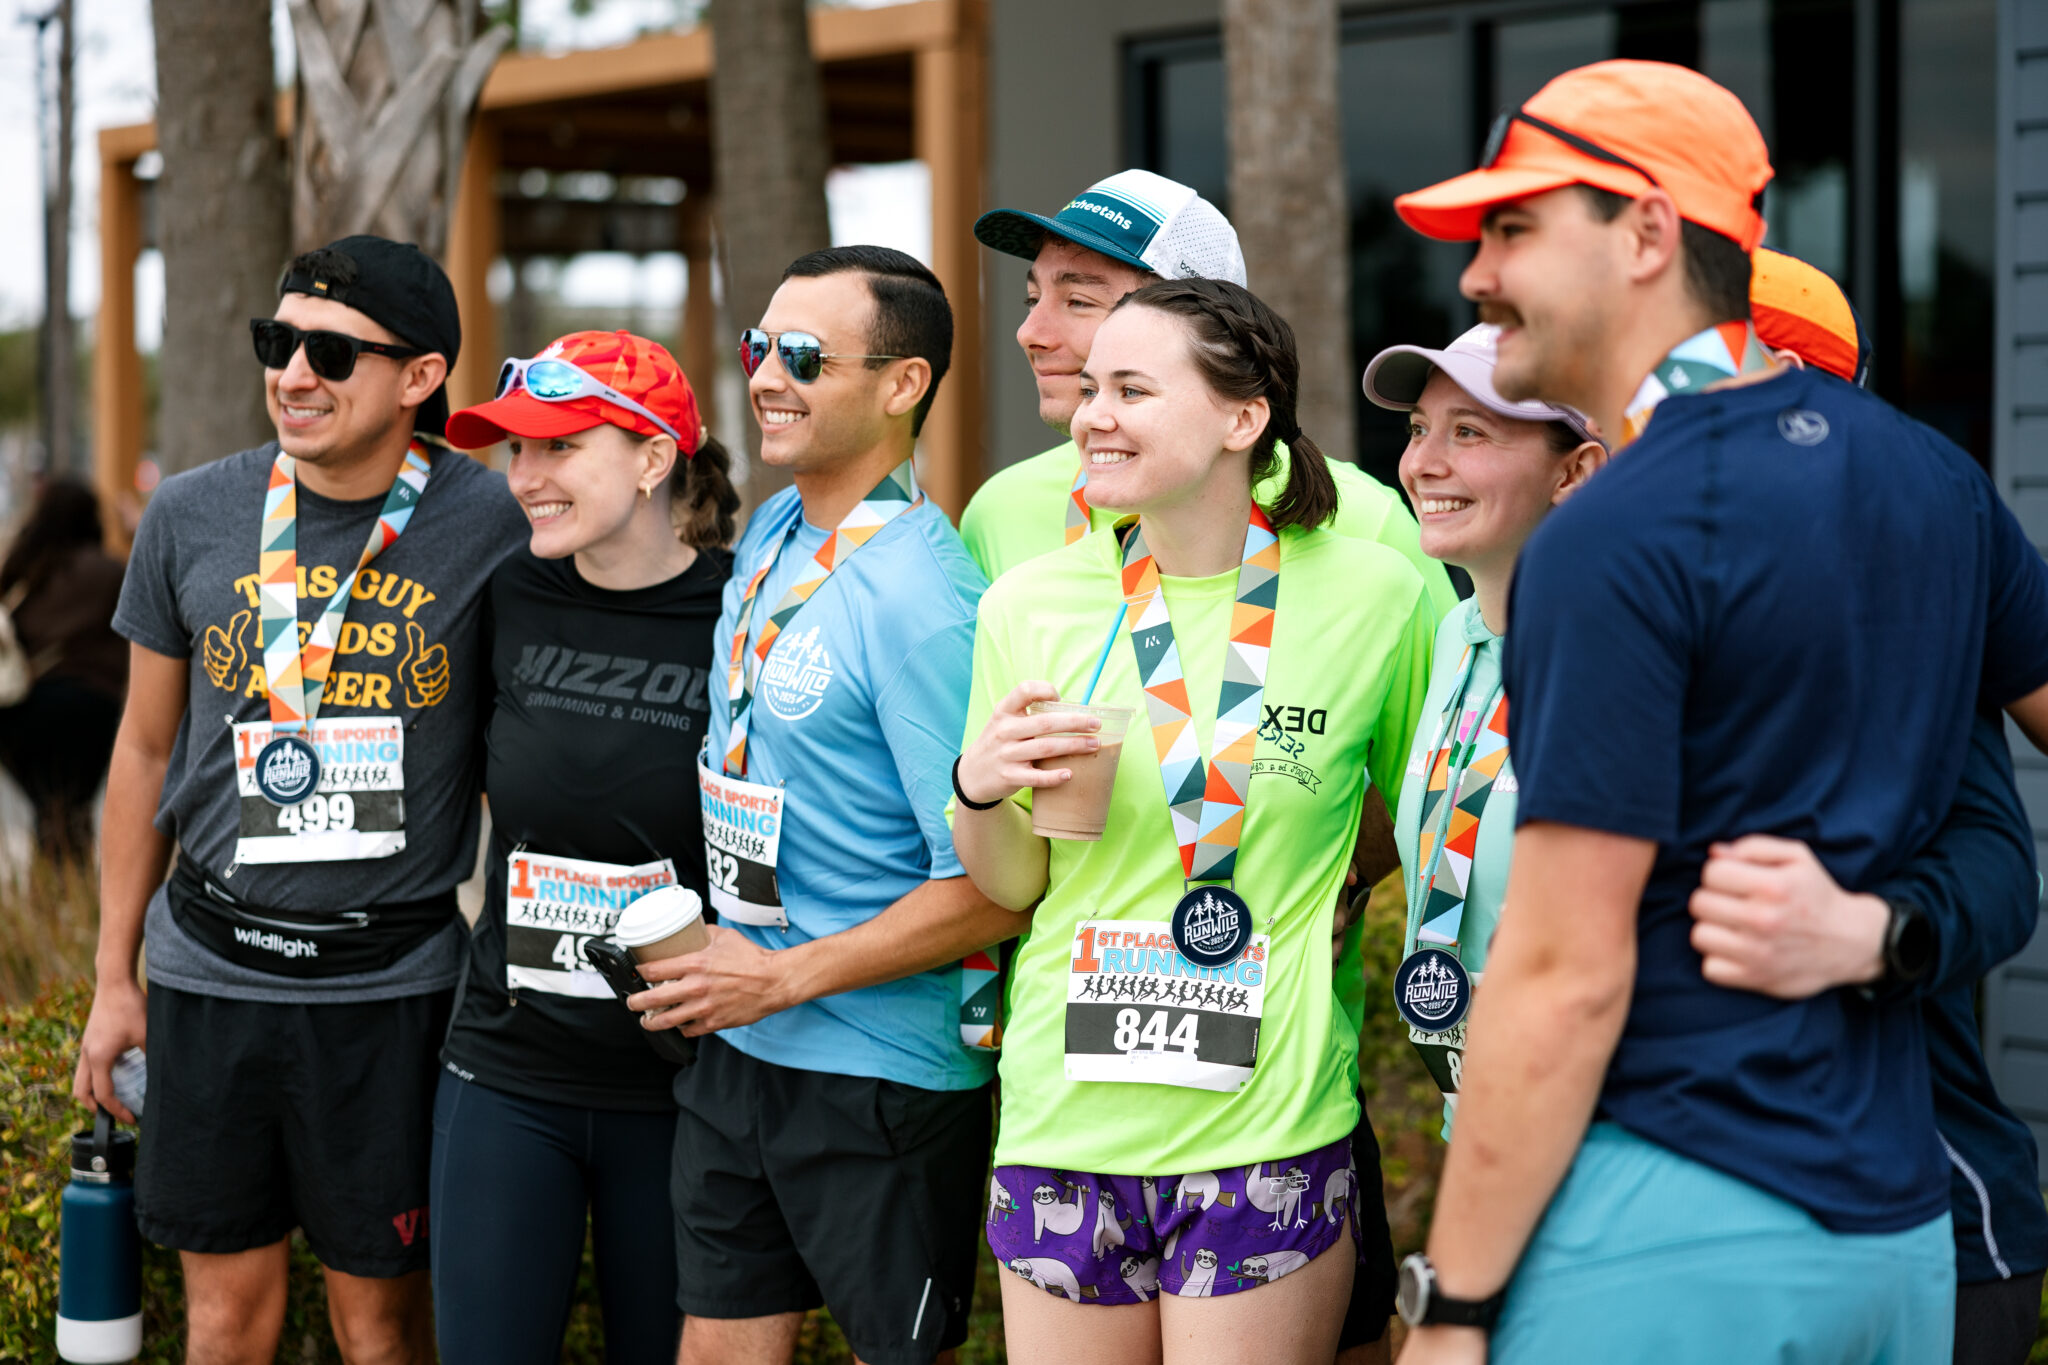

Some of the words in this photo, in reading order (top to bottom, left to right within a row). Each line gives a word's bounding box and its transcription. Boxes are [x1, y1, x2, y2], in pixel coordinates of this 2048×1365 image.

[1071, 199, 1132, 230] cheetahs
[234, 565, 338, 609] TIS
[351, 569, 436, 619] GUY
[526, 692, 606, 717] SWIMMING
[610, 705, 624, 721] &
[630, 707, 692, 731] DIVING
[333, 728, 398, 741] SPORTS
[315, 742, 399, 764] NING
[277, 793, 355, 834] 499
[724, 788, 779, 814] SPORTS
[555, 866, 601, 887] PLACE
[607, 872, 673, 889] SPORTS
[233, 926, 319, 958] wildlight
[1113, 1007, 1200, 1056] 844
